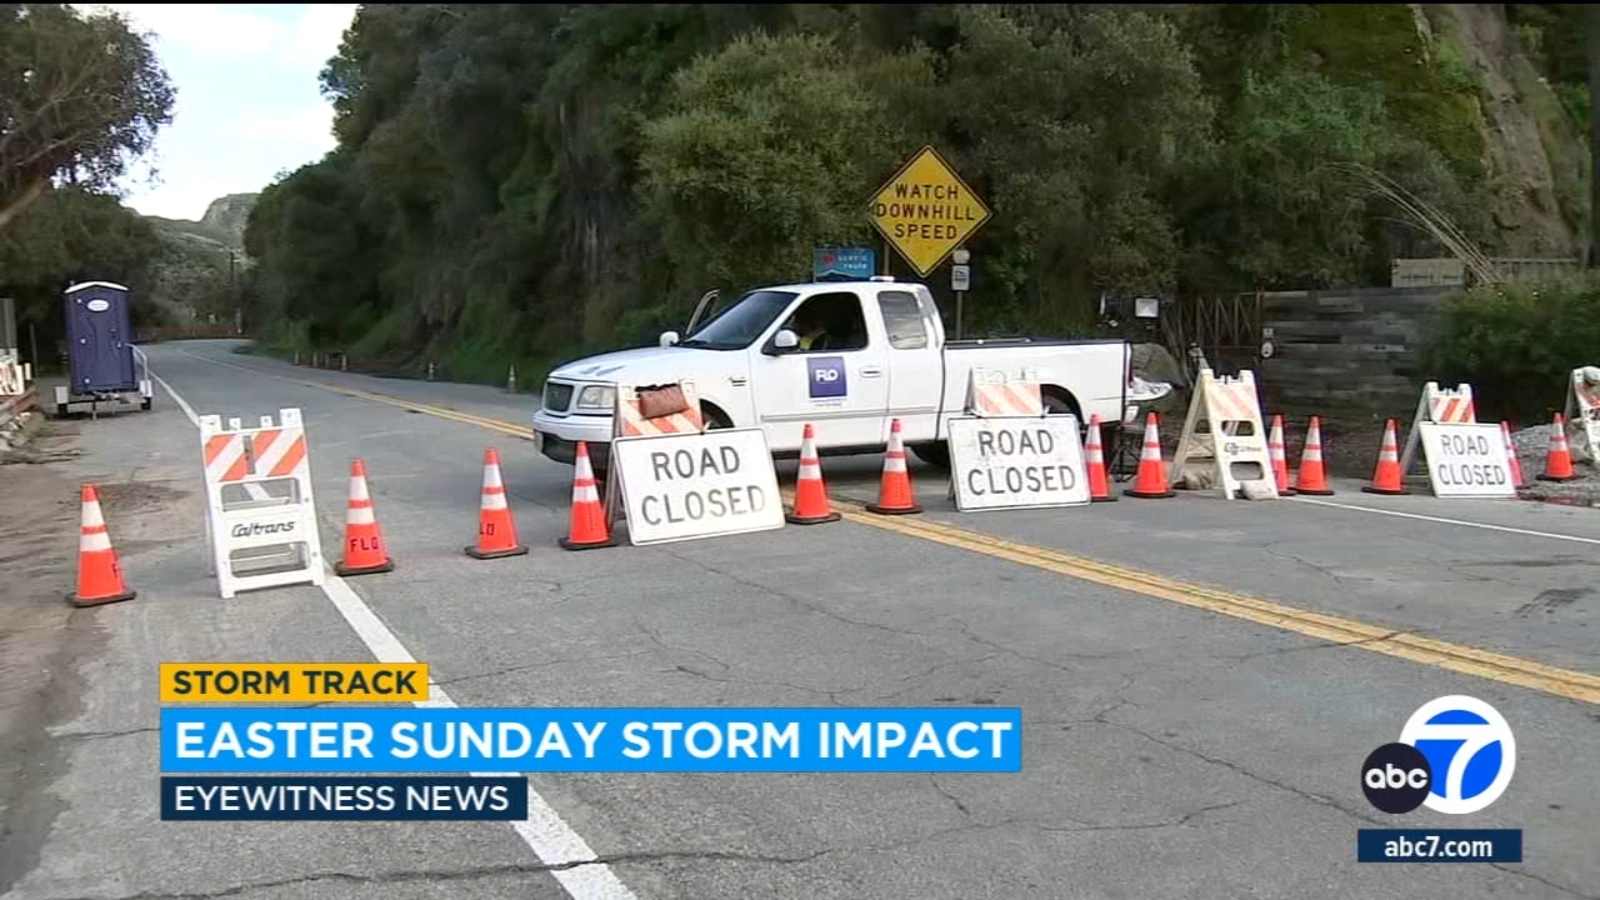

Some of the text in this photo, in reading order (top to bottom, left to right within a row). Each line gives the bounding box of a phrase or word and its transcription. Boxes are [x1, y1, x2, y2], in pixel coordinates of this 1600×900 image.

[894, 183, 959, 200] WATCH
[876, 203, 975, 220] DOWNHILL
[894, 224, 957, 240] SPEED
[977, 429, 1054, 457] ROAD
[1440, 433, 1490, 457] ROAD
[650, 445, 740, 481] ROAD
[967, 465, 1076, 496] CLOSED
[1437, 464, 1506, 487] CLOSED
[641, 484, 766, 527] CLOSED
[231, 520, 296, 538] Caltrans
[350, 536, 379, 552] FLO
